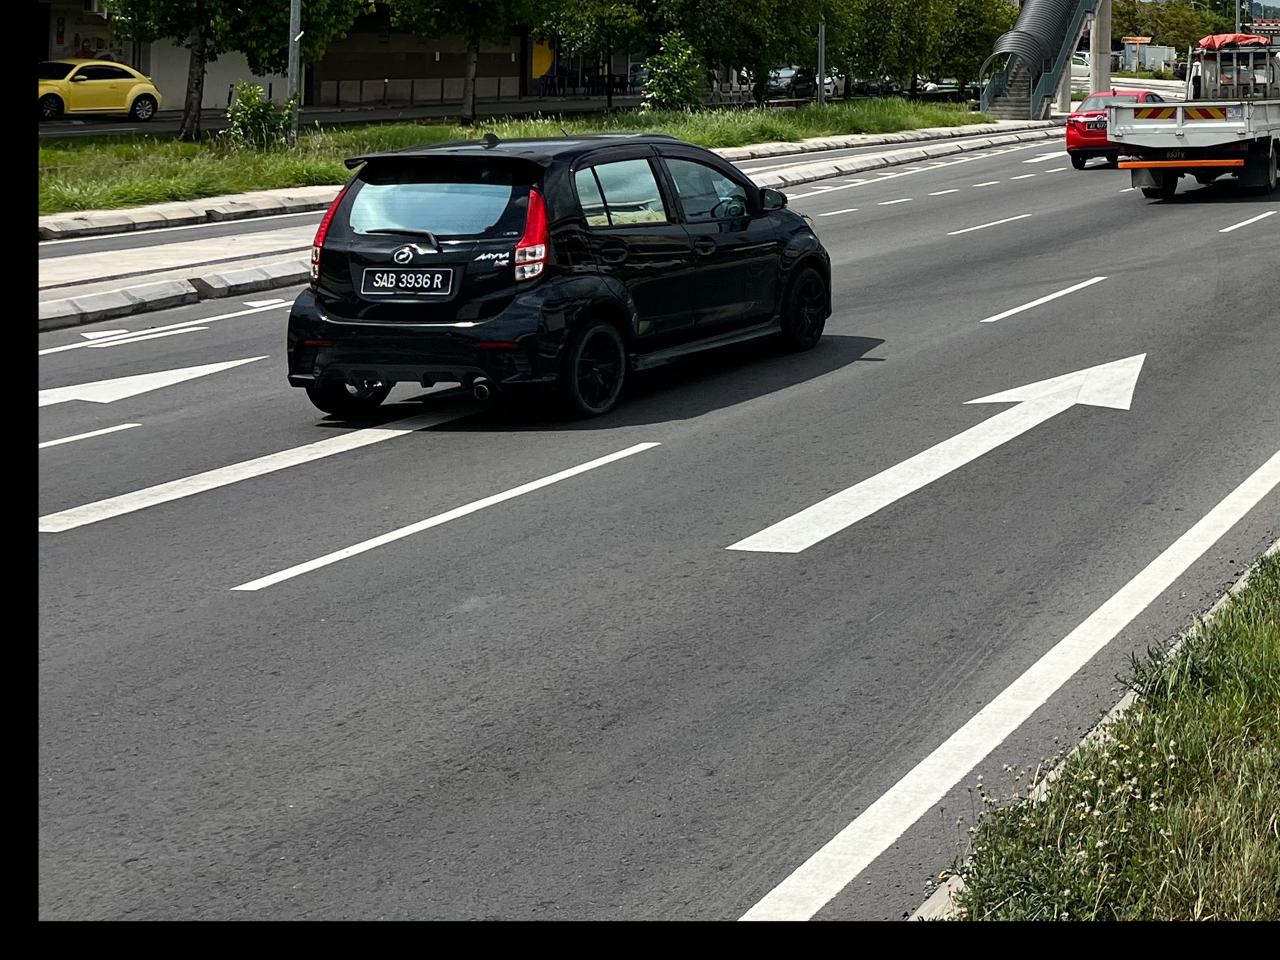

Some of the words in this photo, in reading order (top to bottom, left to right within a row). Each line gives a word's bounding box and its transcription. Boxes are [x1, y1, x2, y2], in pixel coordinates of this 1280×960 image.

[373, 273, 396, 288] SAB
[398, 273, 431, 288] 3936
[433, 273, 443, 288] R
